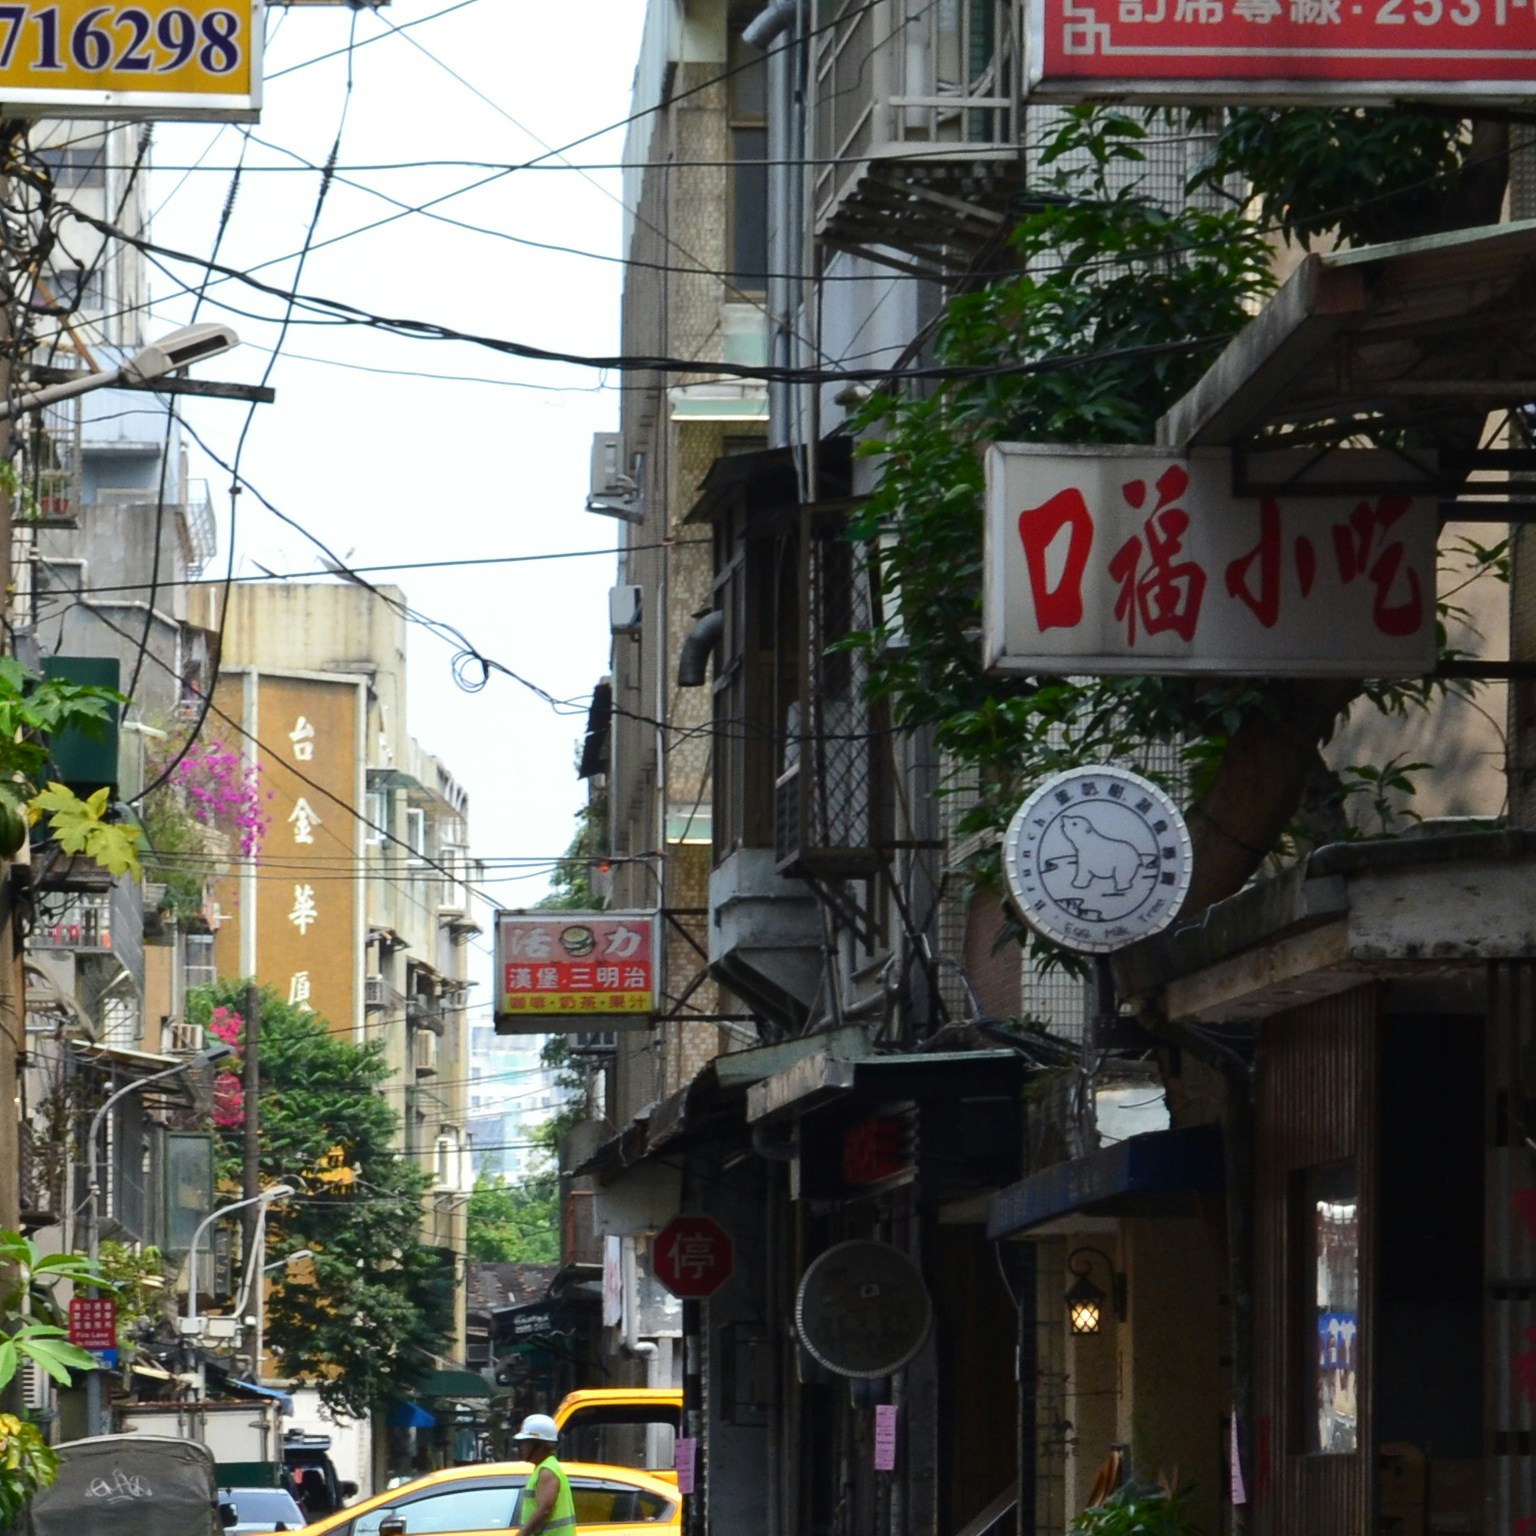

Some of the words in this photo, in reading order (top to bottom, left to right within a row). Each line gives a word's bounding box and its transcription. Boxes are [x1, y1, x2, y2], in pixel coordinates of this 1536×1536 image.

[1018, 463, 1423, 648] 口福小吃
[667, 1232, 715, 1280] 停
